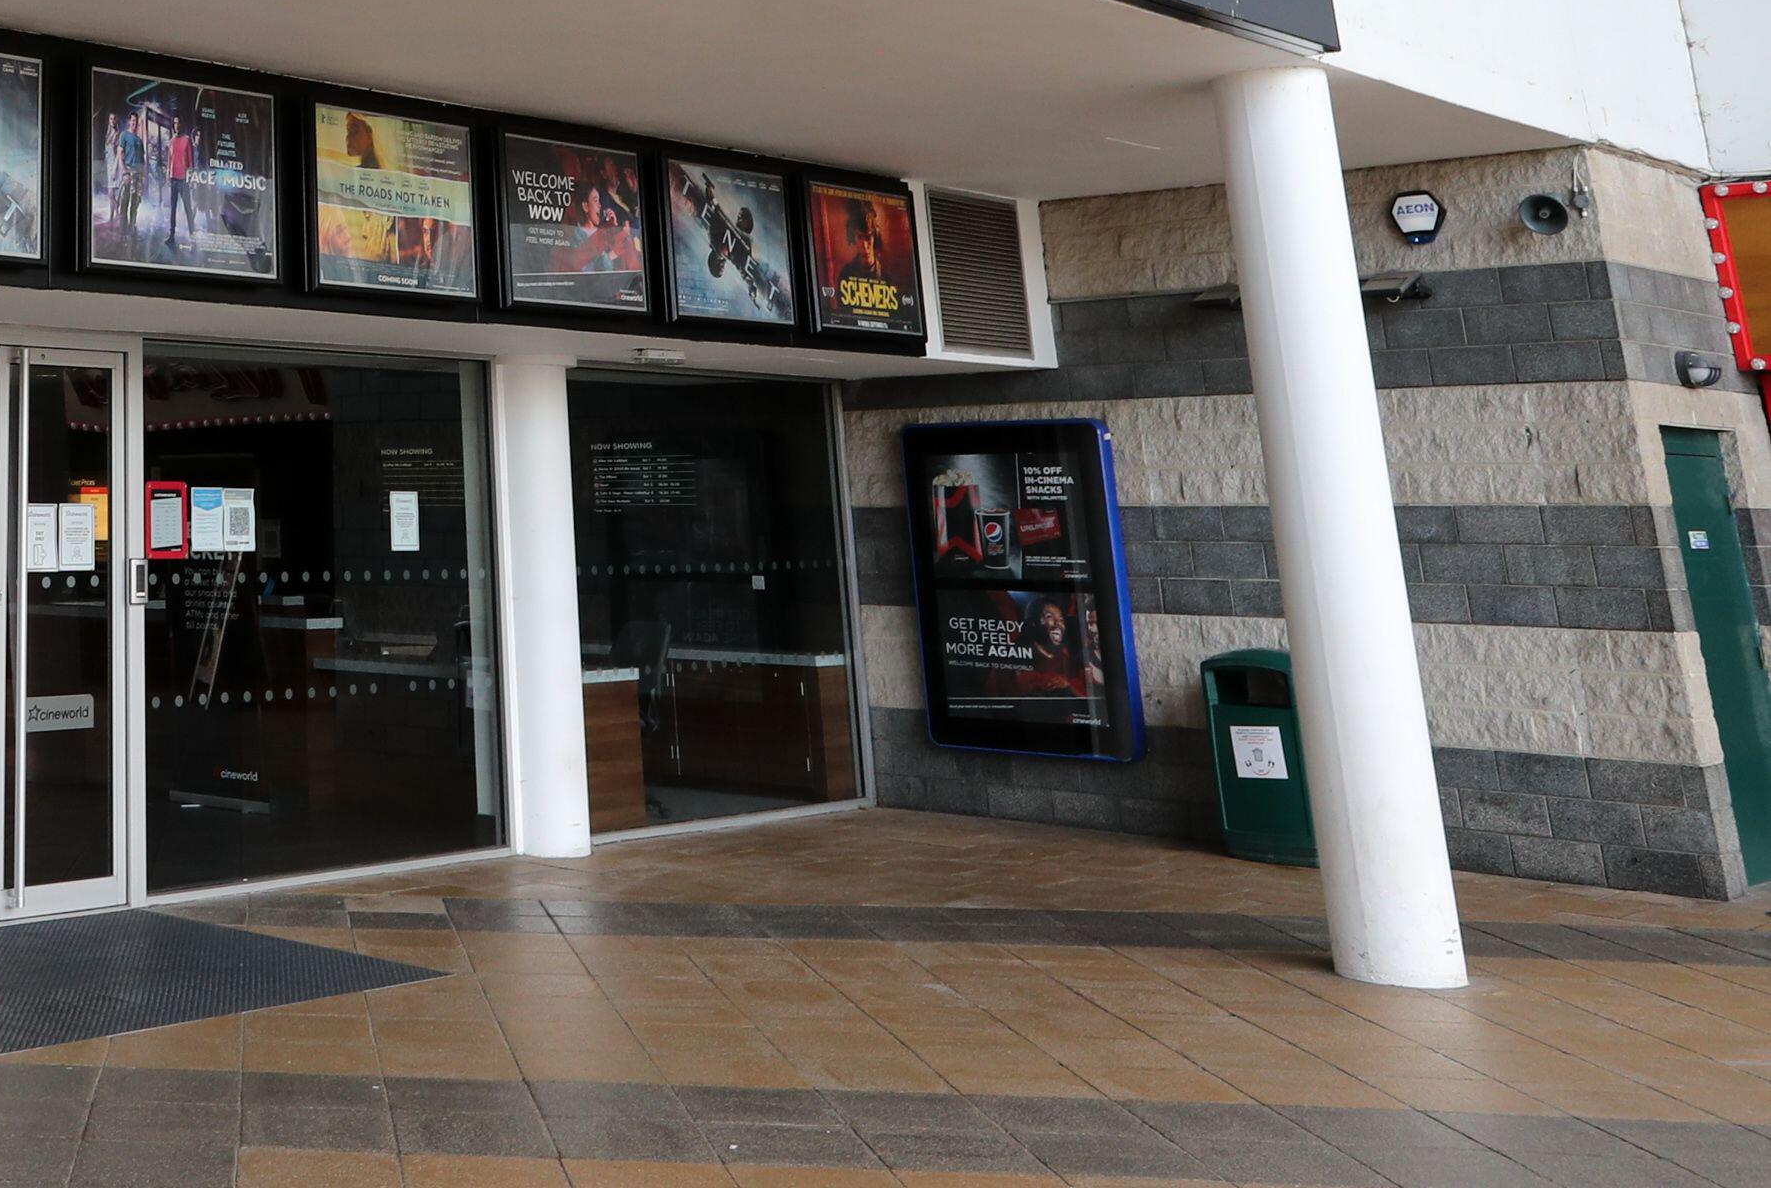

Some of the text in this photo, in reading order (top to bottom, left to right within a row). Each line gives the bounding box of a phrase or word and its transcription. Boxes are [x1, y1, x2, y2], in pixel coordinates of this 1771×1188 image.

[186, 170, 267, 191] FACE MUSIC
[512, 169, 575, 191] WELCOME
[340, 182, 356, 195] THE
[359, 185, 392, 201] ROADS
[396, 191, 415, 204] NOT
[418, 194, 450, 208] TAKEN
[517, 186, 571, 207] BACK TO
[528, 204, 564, 222] WOW
[1397, 203, 1434, 215] AEON
[378, 274, 418, 285] COMING SOON
[840, 279, 899, 310] SCHEMERS
[613, 442, 652, 450] SHOWING
[1023, 467, 1062, 475] 10% OFF
[1024, 476, 1074, 485] IN-CINEMA
[1025, 486, 1063, 494] SNACKS
[949, 617, 1024, 633] GET READY
[960, 630, 1016, 645] TO FEEL
[946, 643, 1033, 659] MORE AGAIN
[40, 706, 89, 721] cineworld
[220, 769, 258, 782] cineworld
